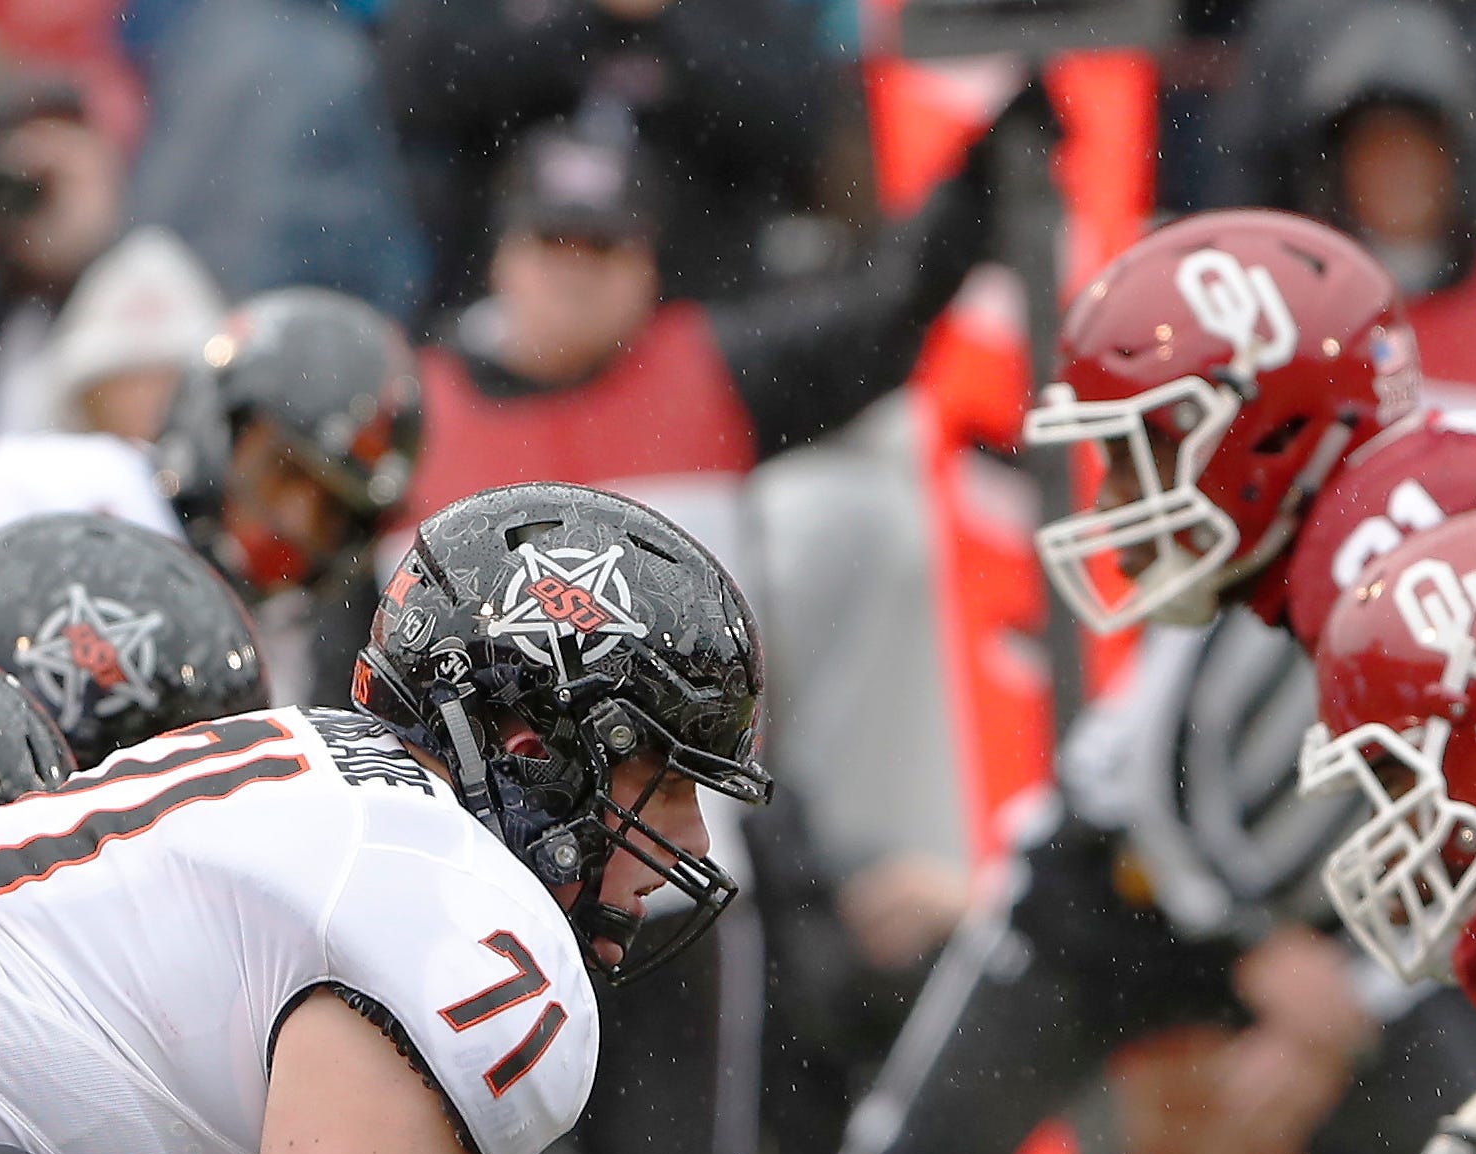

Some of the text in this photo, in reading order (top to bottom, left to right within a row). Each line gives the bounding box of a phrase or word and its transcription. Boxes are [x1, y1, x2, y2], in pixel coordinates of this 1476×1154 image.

[1176, 248, 1298, 370] OU
[525, 576, 614, 635] OSU
[437, 929, 568, 1099] 71
